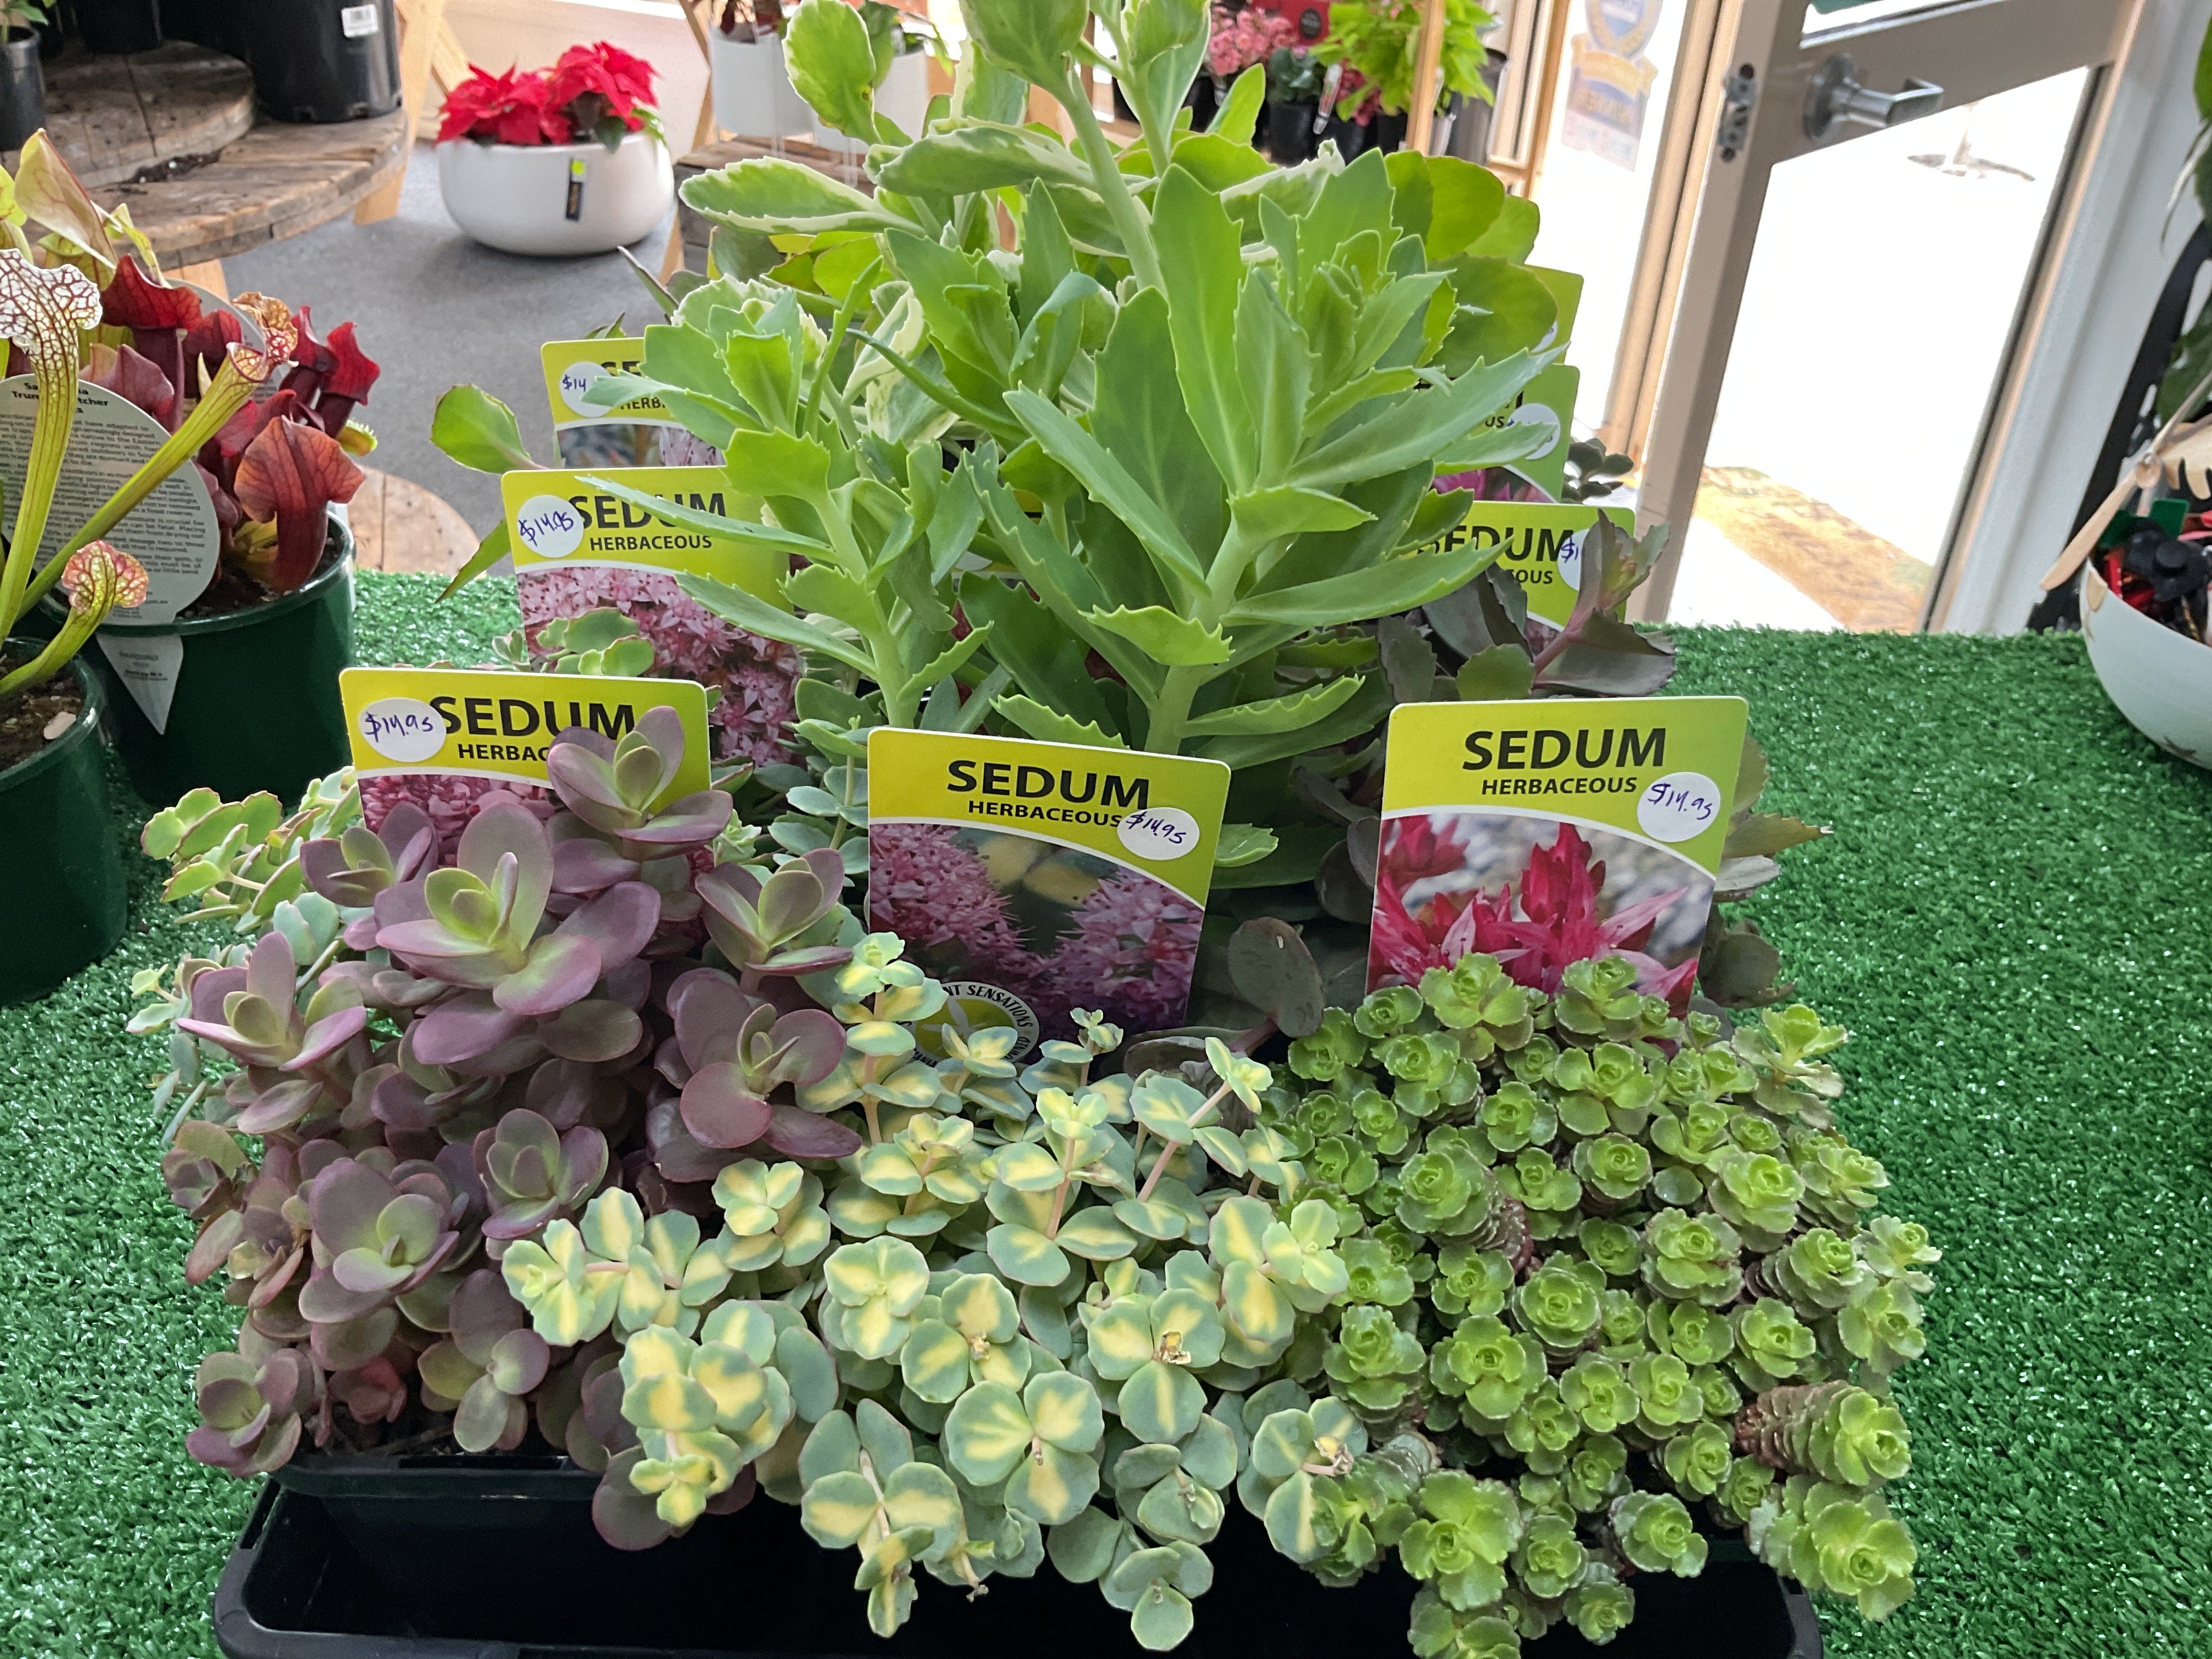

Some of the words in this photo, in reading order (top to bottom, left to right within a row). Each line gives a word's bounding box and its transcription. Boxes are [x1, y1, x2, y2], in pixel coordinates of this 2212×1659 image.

[78, 397, 109, 407] tcher
[589, 535, 713, 551] HERBACEOUS
[429, 696, 636, 740] SEDUM
[458, 743, 550, 762] HERBAC
[1462, 727, 1667, 770] SEDUM
[947, 759, 1150, 810] SEDUM
[1481, 776, 1638, 795] HERBACEOUS
[968, 800, 1122, 828] HERBACEOUS
[967, 984, 1033, 1028] SENSATIONS
